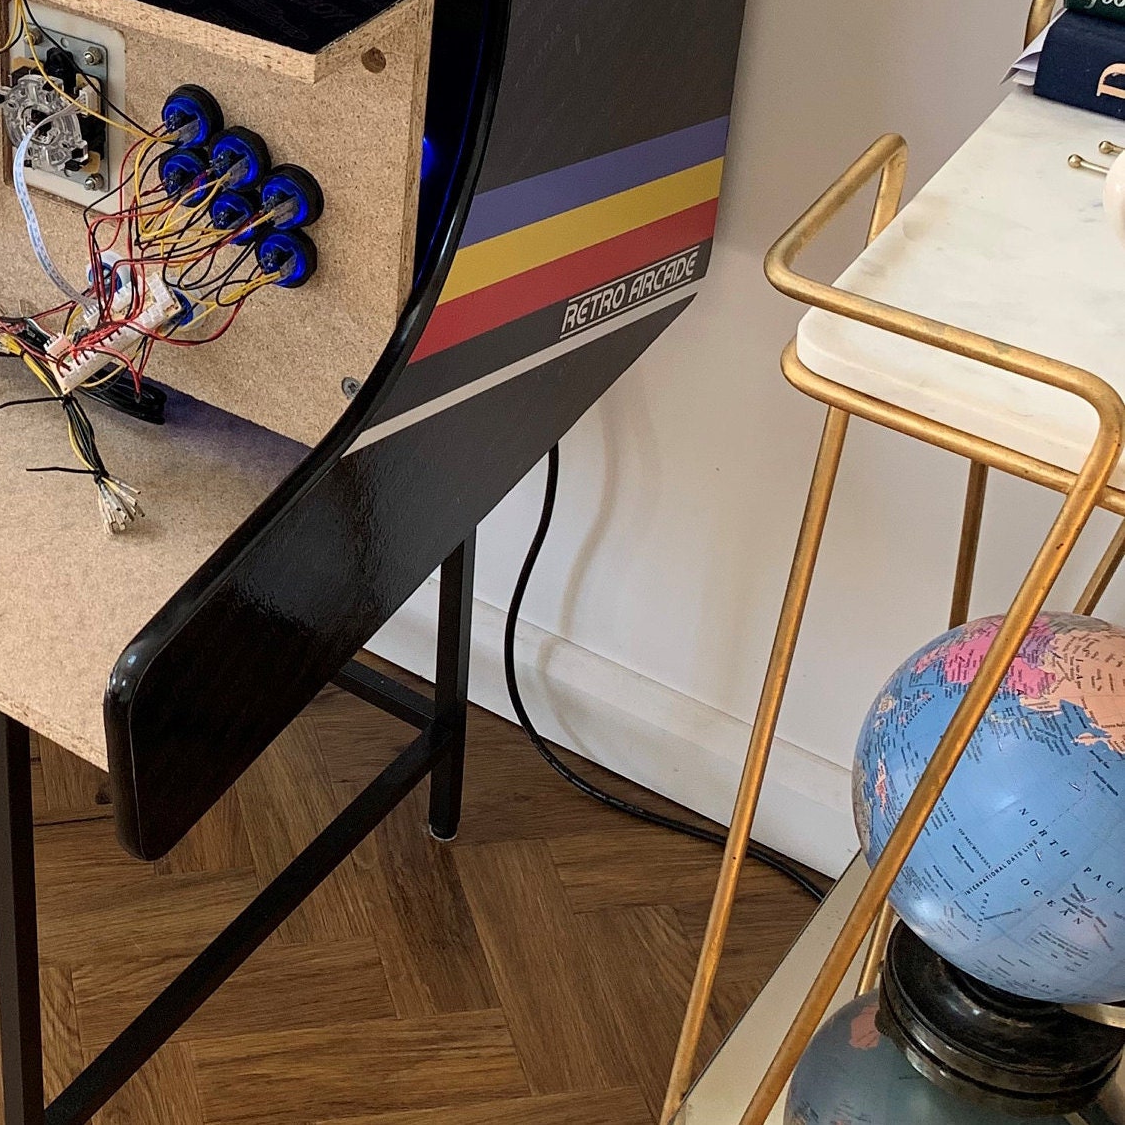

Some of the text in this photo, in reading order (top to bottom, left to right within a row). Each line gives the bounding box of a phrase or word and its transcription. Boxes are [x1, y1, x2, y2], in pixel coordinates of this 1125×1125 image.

[561, 250, 699, 333] RETRO ARCADE
[1019, 807, 1071, 858] NORTH
[964, 865, 1007, 896] INTERNATIONAL
[1006, 851, 1024, 866] DATE
[1023, 839, 1039, 854] LINE
[1020, 878, 1083, 925] OCEAN
